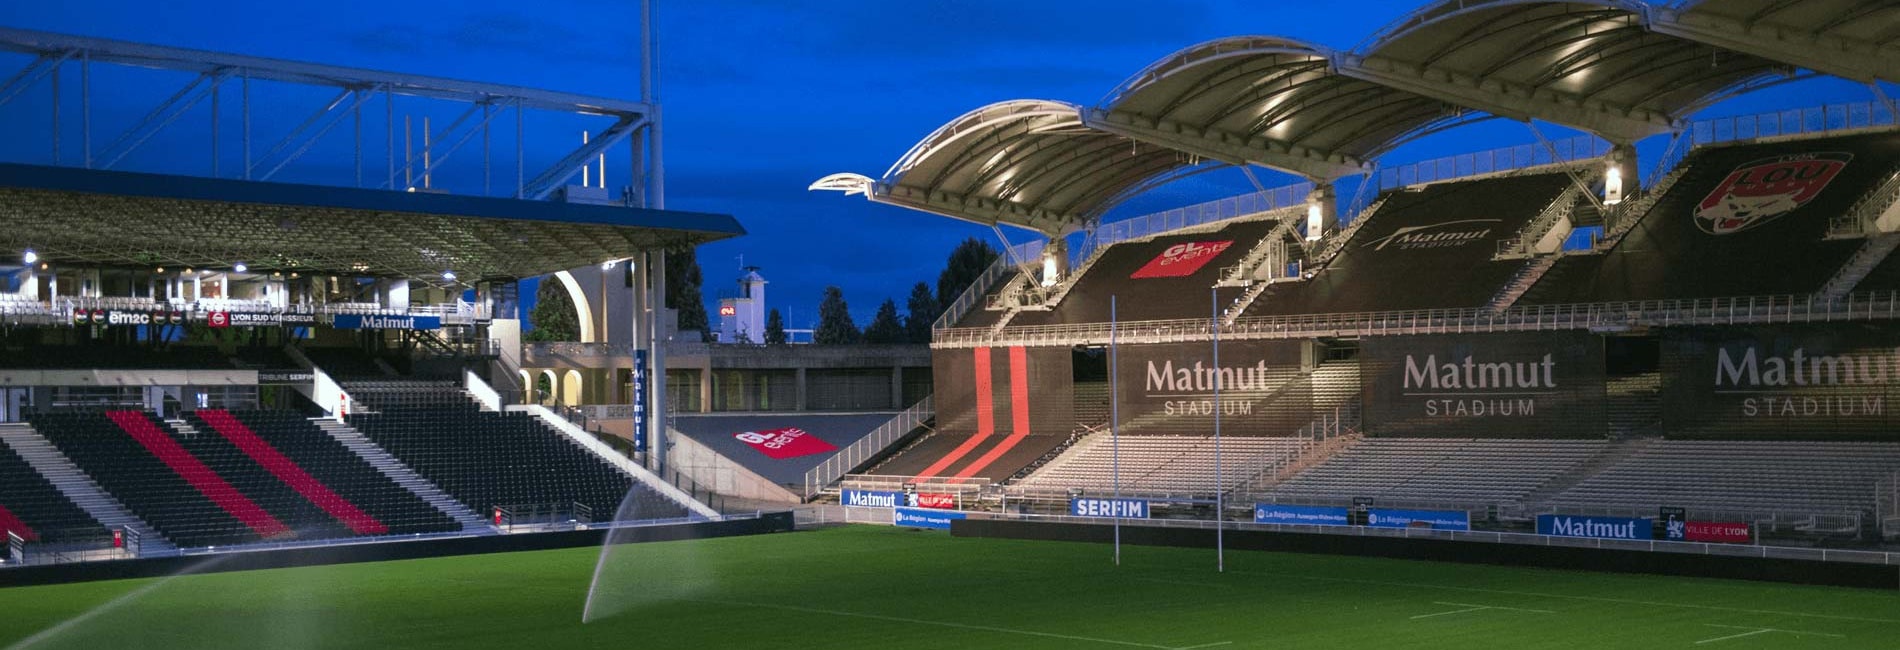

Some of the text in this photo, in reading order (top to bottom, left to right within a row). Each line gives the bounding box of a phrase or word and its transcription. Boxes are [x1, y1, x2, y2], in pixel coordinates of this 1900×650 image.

[1733, 163, 1830, 185] LOU
[1396, 228, 1491, 244] Matmut
[1160, 243, 1231, 266] events
[1163, 242, 1205, 258] GL
[109, 311, 150, 324] em2c
[360, 315, 415, 329] Matmut
[1146, 359, 1269, 391] Matmut
[1403, 353, 1557, 389] Matmut
[633, 369, 644, 435] Matmut
[1164, 401, 1252, 416] STADUM
[1426, 399, 1535, 416] STADIUM
[1743, 396, 1882, 416] STADIUM
[736, 431, 776, 444] GL
[849, 491, 895, 506] Matmut
[1077, 500, 1142, 517] SERFIM
[1552, 516, 1637, 538] Matmut
[1686, 525, 1748, 536] VILLE DE LYON
